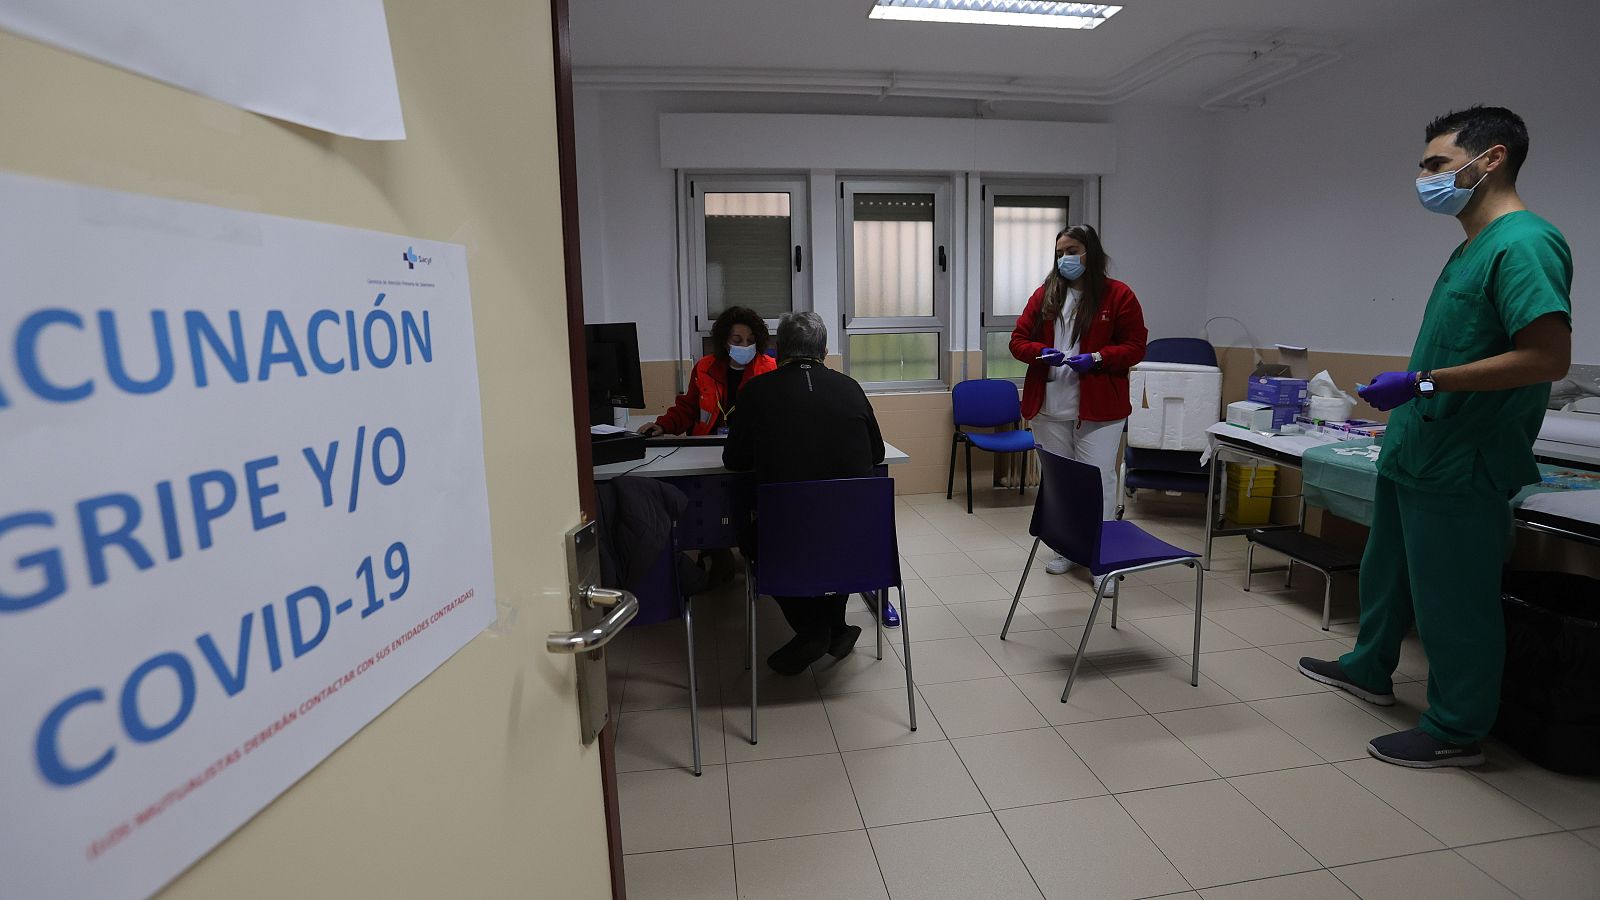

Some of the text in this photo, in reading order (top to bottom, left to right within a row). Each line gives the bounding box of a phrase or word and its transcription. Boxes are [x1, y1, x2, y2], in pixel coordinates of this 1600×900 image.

[0, 293, 433, 410] CUNACIÓN
[0, 426, 406, 614] GRIPE Y/O
[35, 542, 411, 787] COVID-19
[243, 708, 298, 755] DEBERÁN
[299, 669, 356, 716] CONTACTAR
[356, 656, 375, 676] CON
[375, 646, 391, 663] SUS
[391, 619, 430, 651] ENTIDADES
[430, 588, 474, 625] CONTRATADAS)
